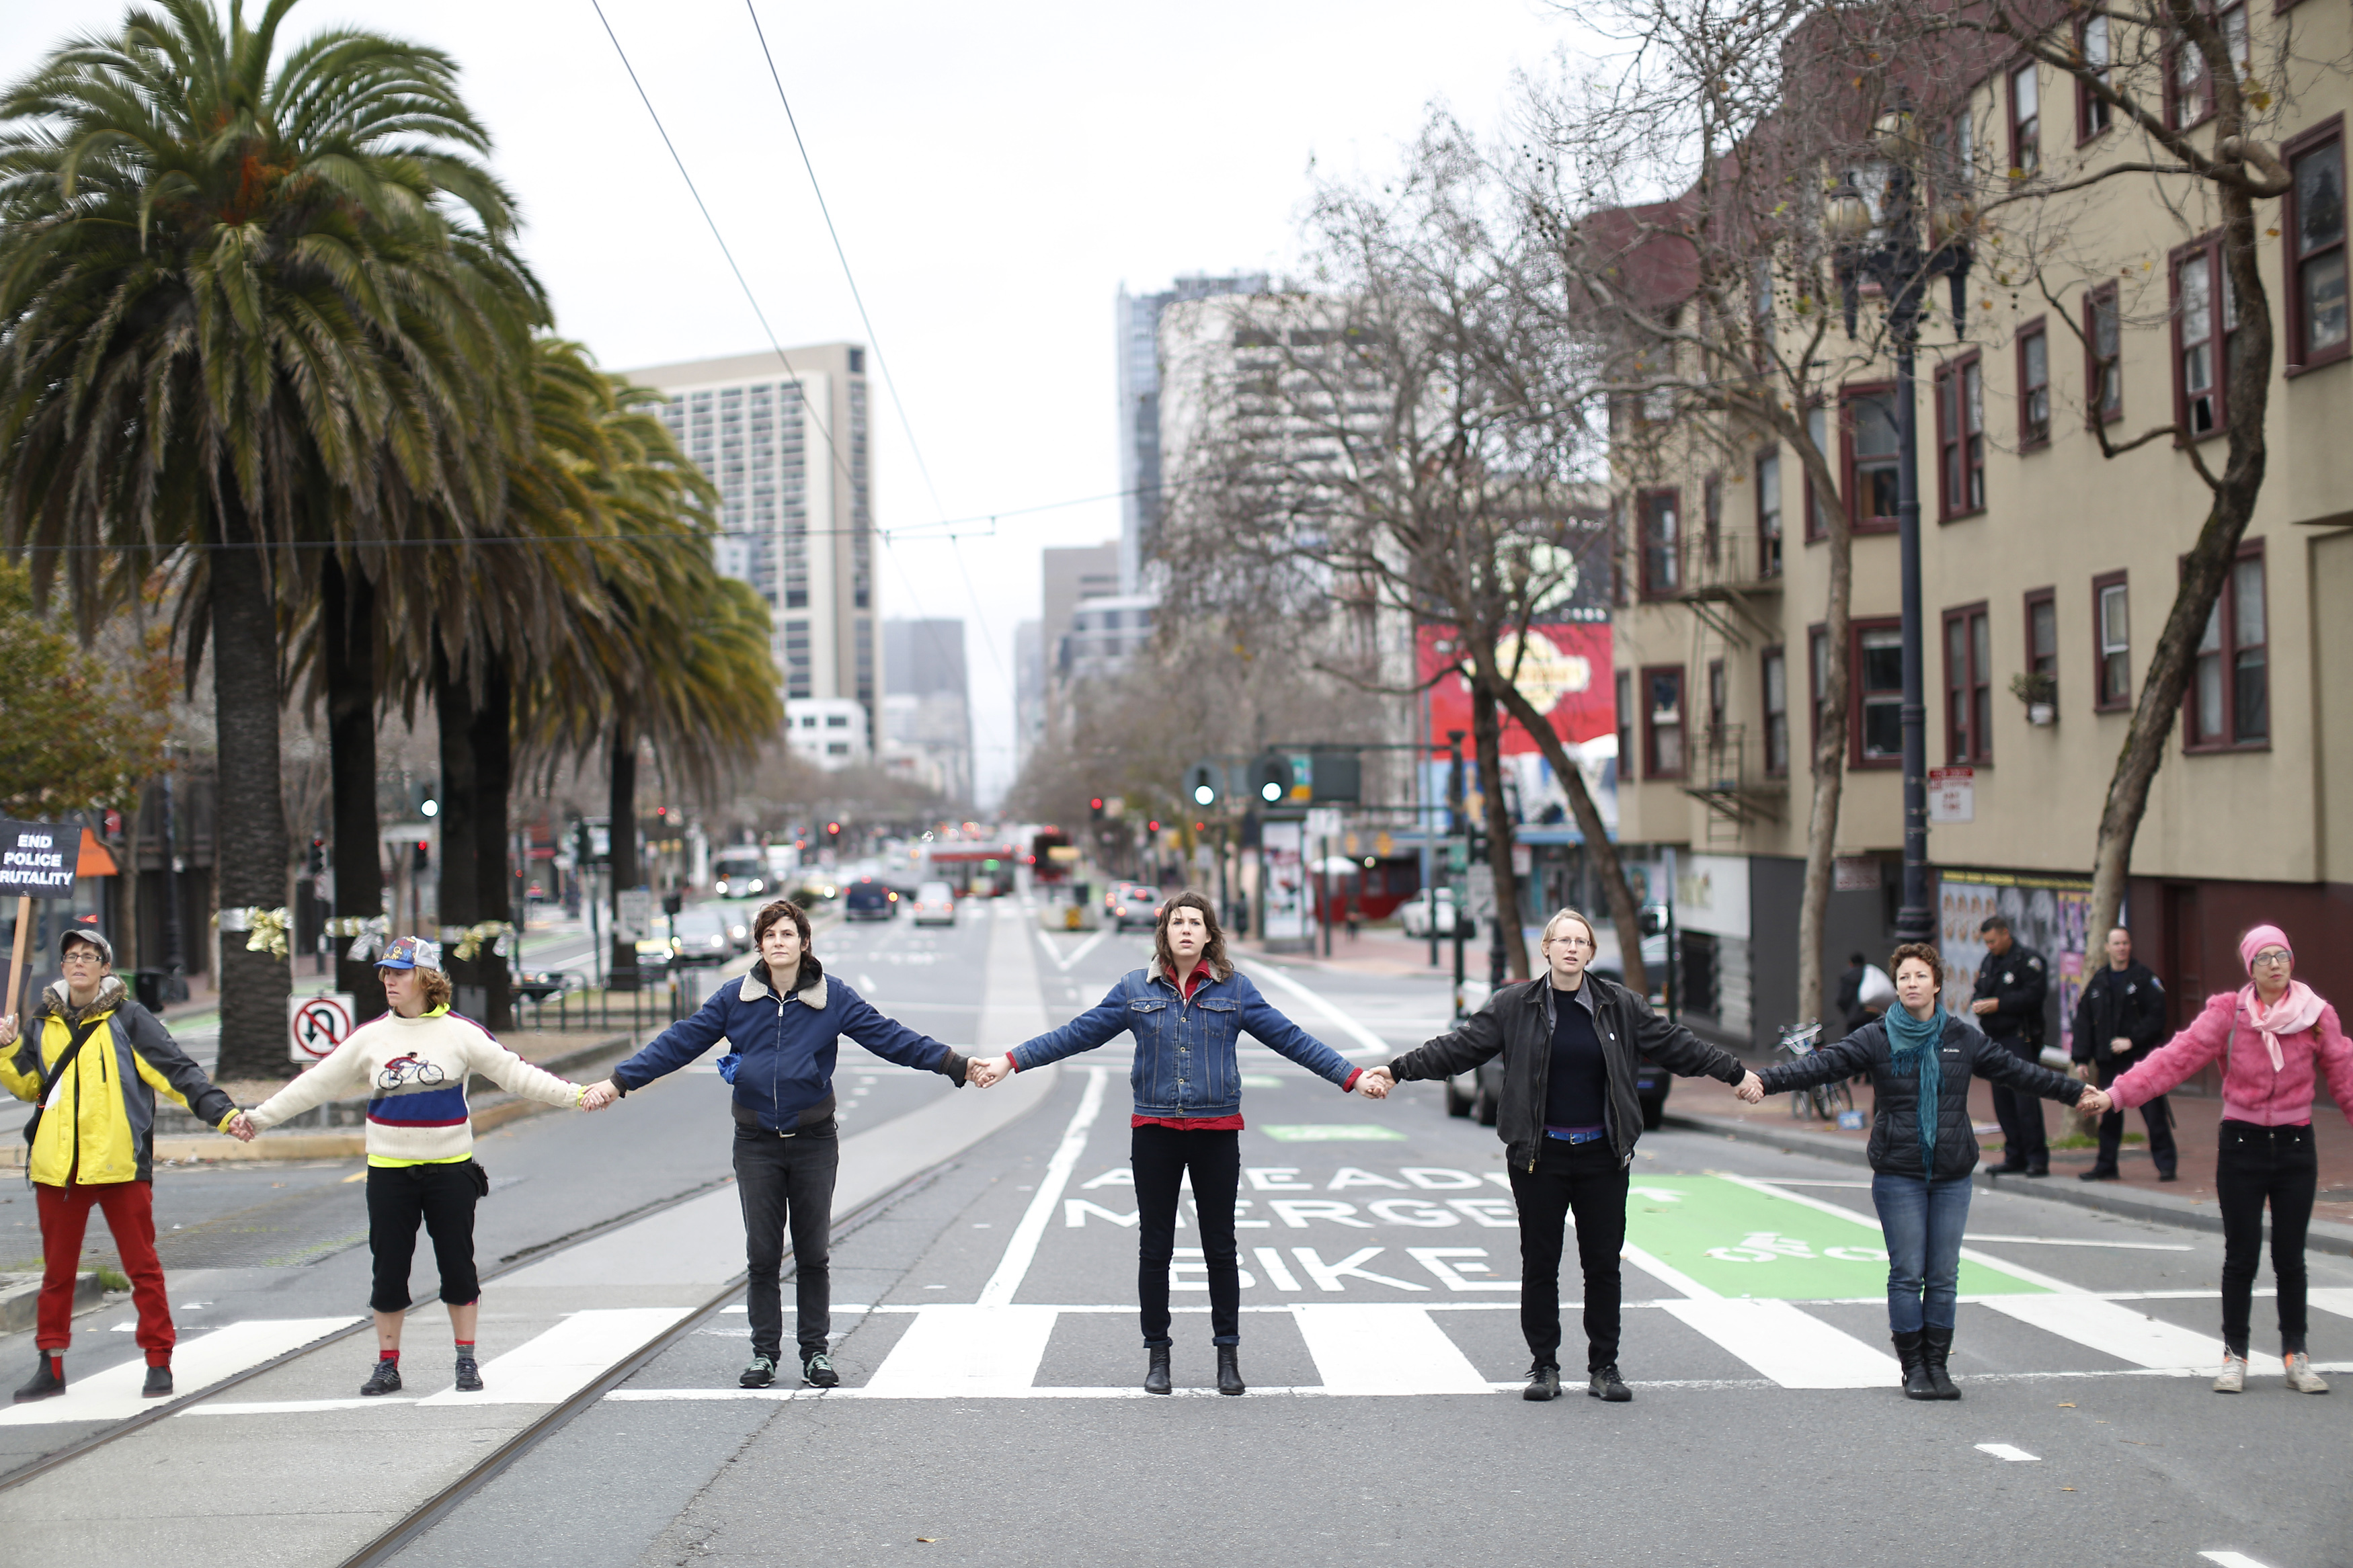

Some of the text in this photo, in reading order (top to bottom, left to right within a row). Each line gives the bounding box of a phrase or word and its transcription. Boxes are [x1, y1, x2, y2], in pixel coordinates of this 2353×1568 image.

[17, 834, 53, 848] END
[3, 852, 62, 867] POLICE
[0, 870, 73, 885] RUTALITY
[1080, 1167, 1483, 1190] AEAD
[1064, 1198, 1520, 1228] MERGE
[1168, 1247, 1523, 1291] BIKE
